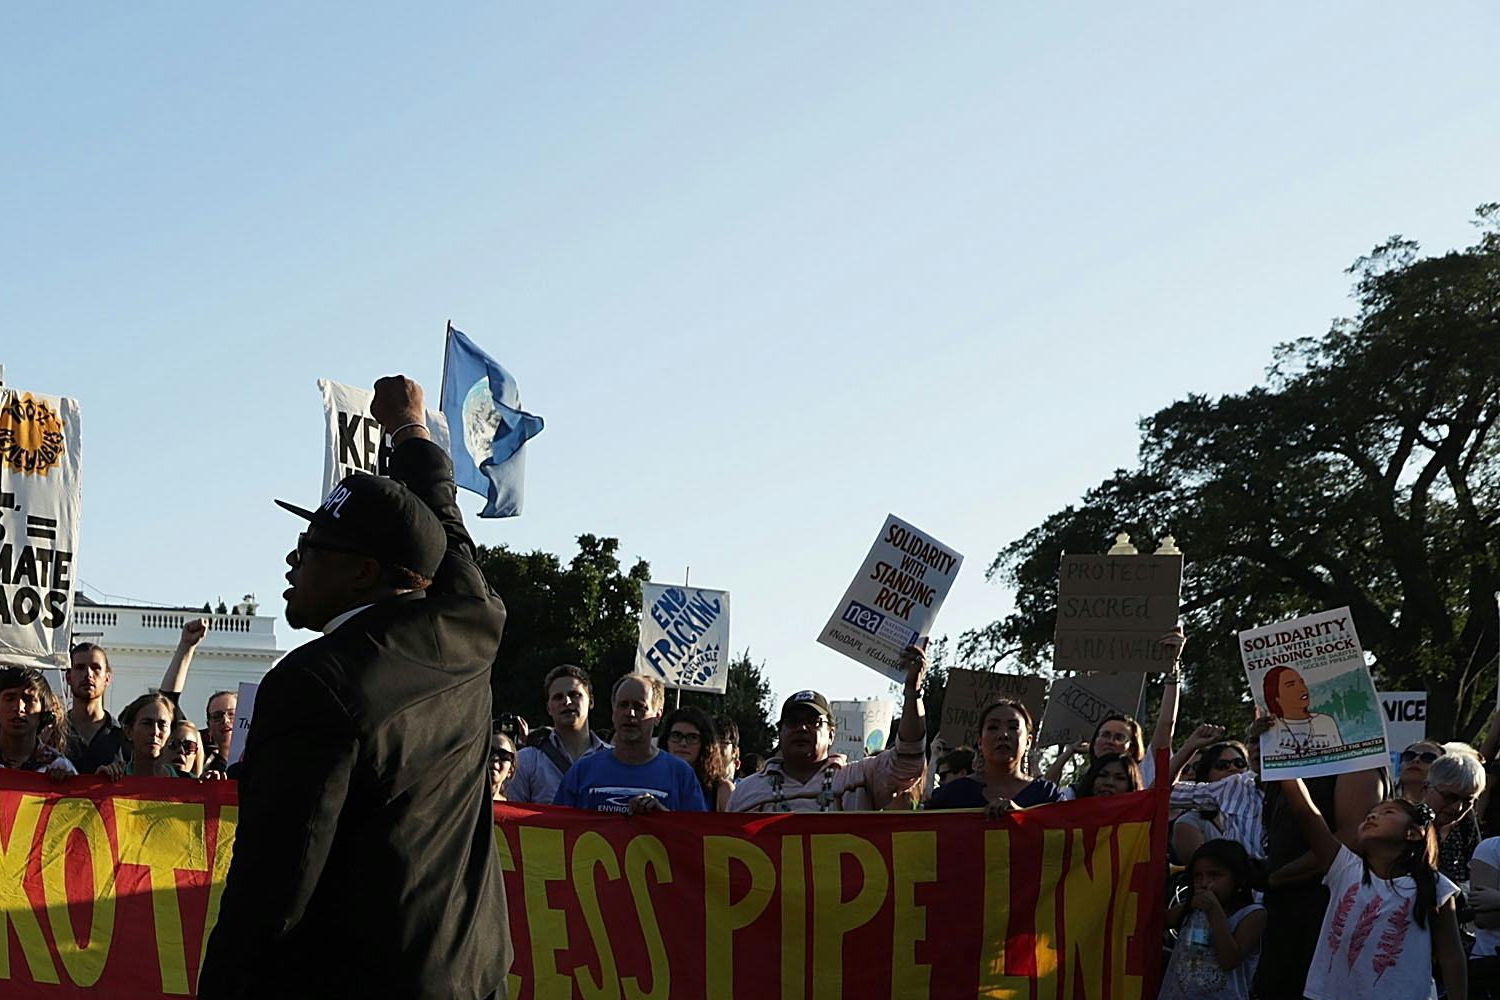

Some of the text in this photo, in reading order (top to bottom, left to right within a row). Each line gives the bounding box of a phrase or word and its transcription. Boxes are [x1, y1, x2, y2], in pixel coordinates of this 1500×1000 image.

[338, 411, 392, 476] KEE
[884, 524, 957, 576] SOLIDARITY
[899, 555, 928, 580] WITH
[870, 561, 936, 608] STANDING
[651, 587, 687, 630] END
[845, 605, 880, 632] nea
[874, 587, 916, 621] ROCK
[646, 589, 721, 678] FRACKING
[1243, 617, 1348, 653] SOLIDARITY
[1284, 640, 1311, 652] WITH
[1247, 638, 1356, 671] STANDING ROCK
[693, 665, 718, 686] 100%
[239, 717, 250, 729] Th
[597, 804, 629, 813] ENVIRO
